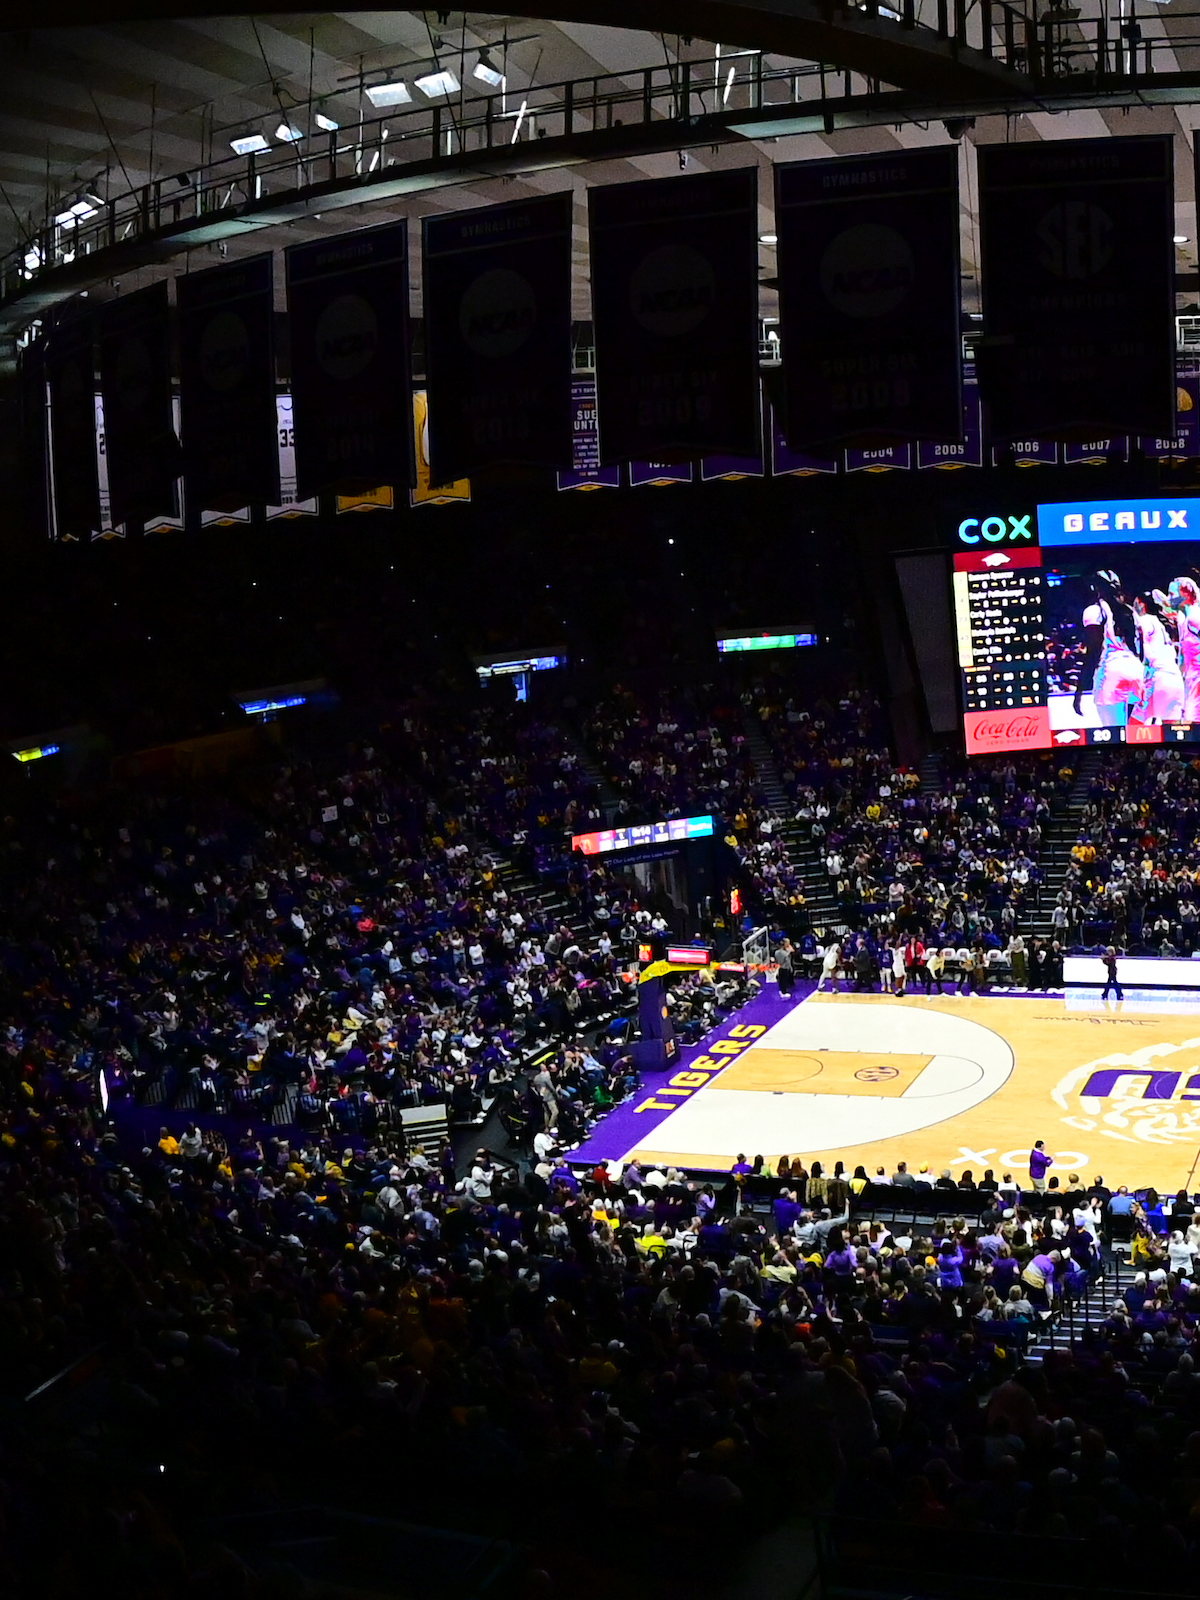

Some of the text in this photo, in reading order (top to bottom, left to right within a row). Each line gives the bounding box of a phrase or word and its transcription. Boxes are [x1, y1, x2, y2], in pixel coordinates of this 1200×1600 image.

[822, 167, 909, 189] GYMNASTICS
[1036, 199, 1115, 280] SEC
[934, 444, 966, 456] 2005
[958, 515, 1032, 544] COX
[1063, 509, 1189, 534] GEAUX
[973, 715, 1041, 741] Coca-Cola
[1093, 729, 1111, 742] 20
[623, 856, 636, 864] Lady
[634, 1024, 768, 1115] TIGERS
[949, 1146, 1089, 1170] COX
